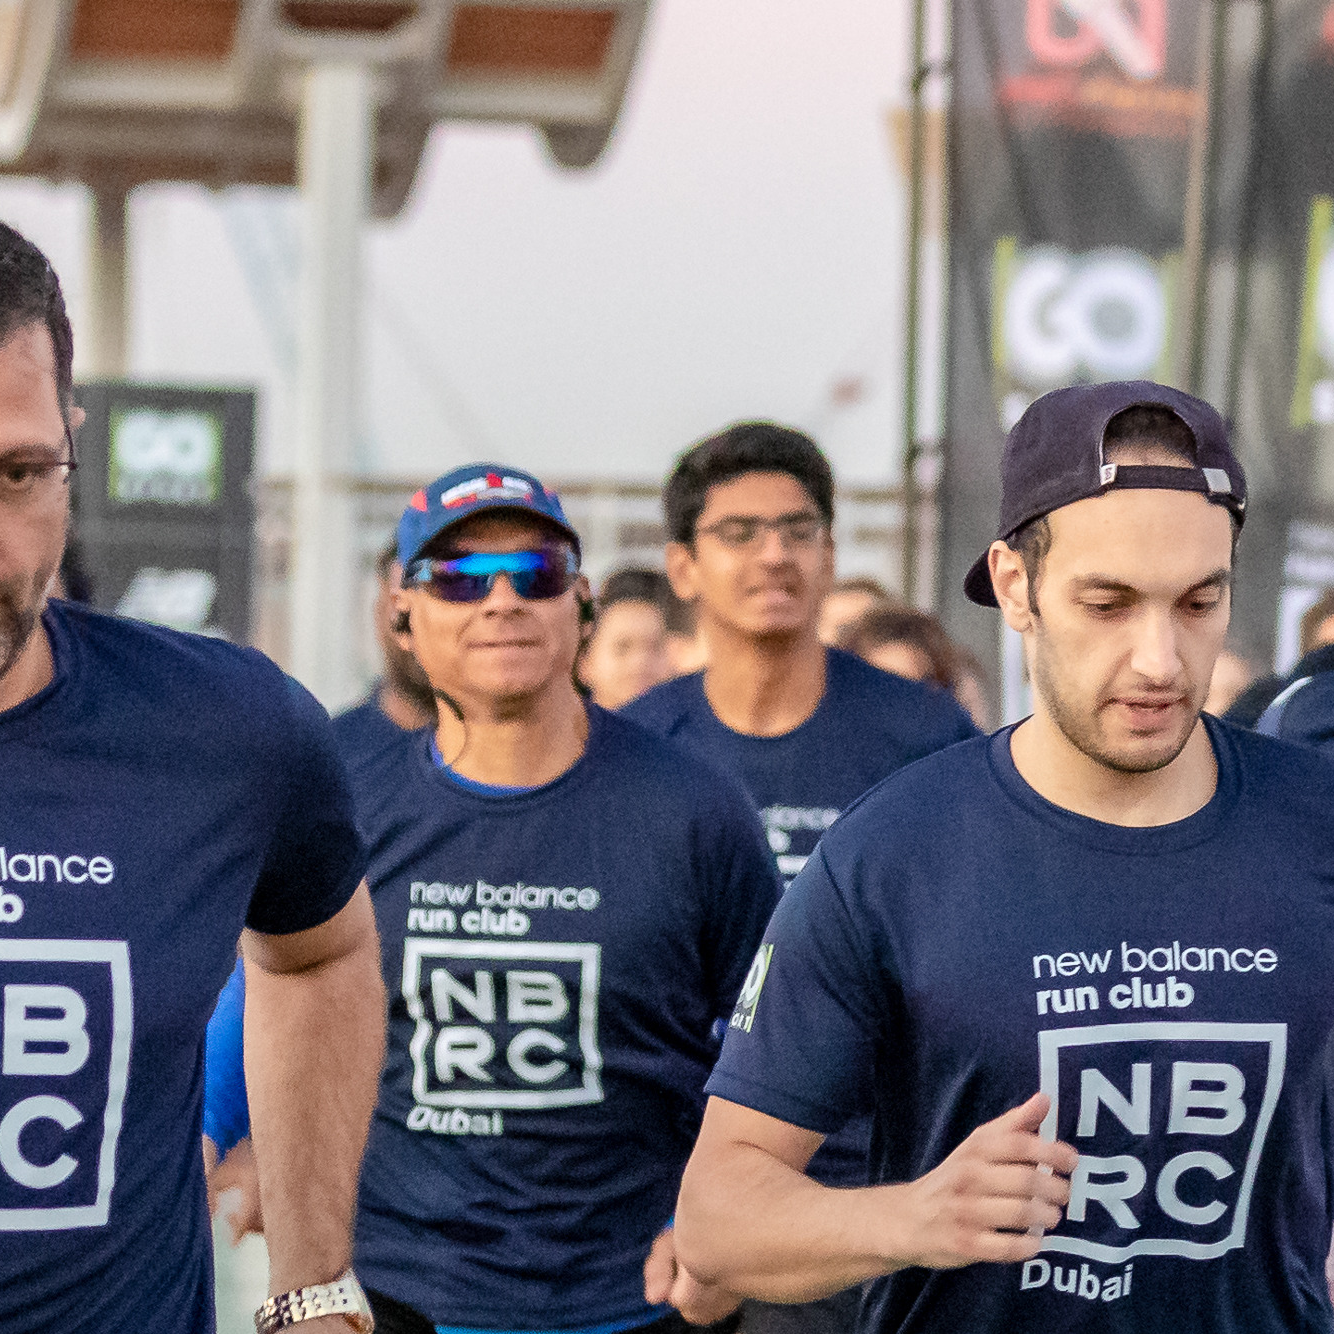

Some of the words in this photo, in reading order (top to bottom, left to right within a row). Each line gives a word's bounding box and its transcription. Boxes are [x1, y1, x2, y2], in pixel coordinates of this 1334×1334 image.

[409, 880, 473, 908] new
[476, 878, 600, 911] balance
[407, 910, 457, 933] run
[462, 908, 531, 937] club
[1033, 948, 1113, 979] new
[1120, 940, 1279, 975] balance
[430, 968, 570, 1026] NB
[1036, 981, 1100, 1016] run
[1108, 975, 1196, 1010] club
[433, 1026, 569, 1085] RC
[406, 1102, 504, 1137] Dubai
[1076, 1060, 1248, 1138] NB
[1067, 1150, 1234, 1231] RC
[1019, 1257, 1134, 1303] Dubai
